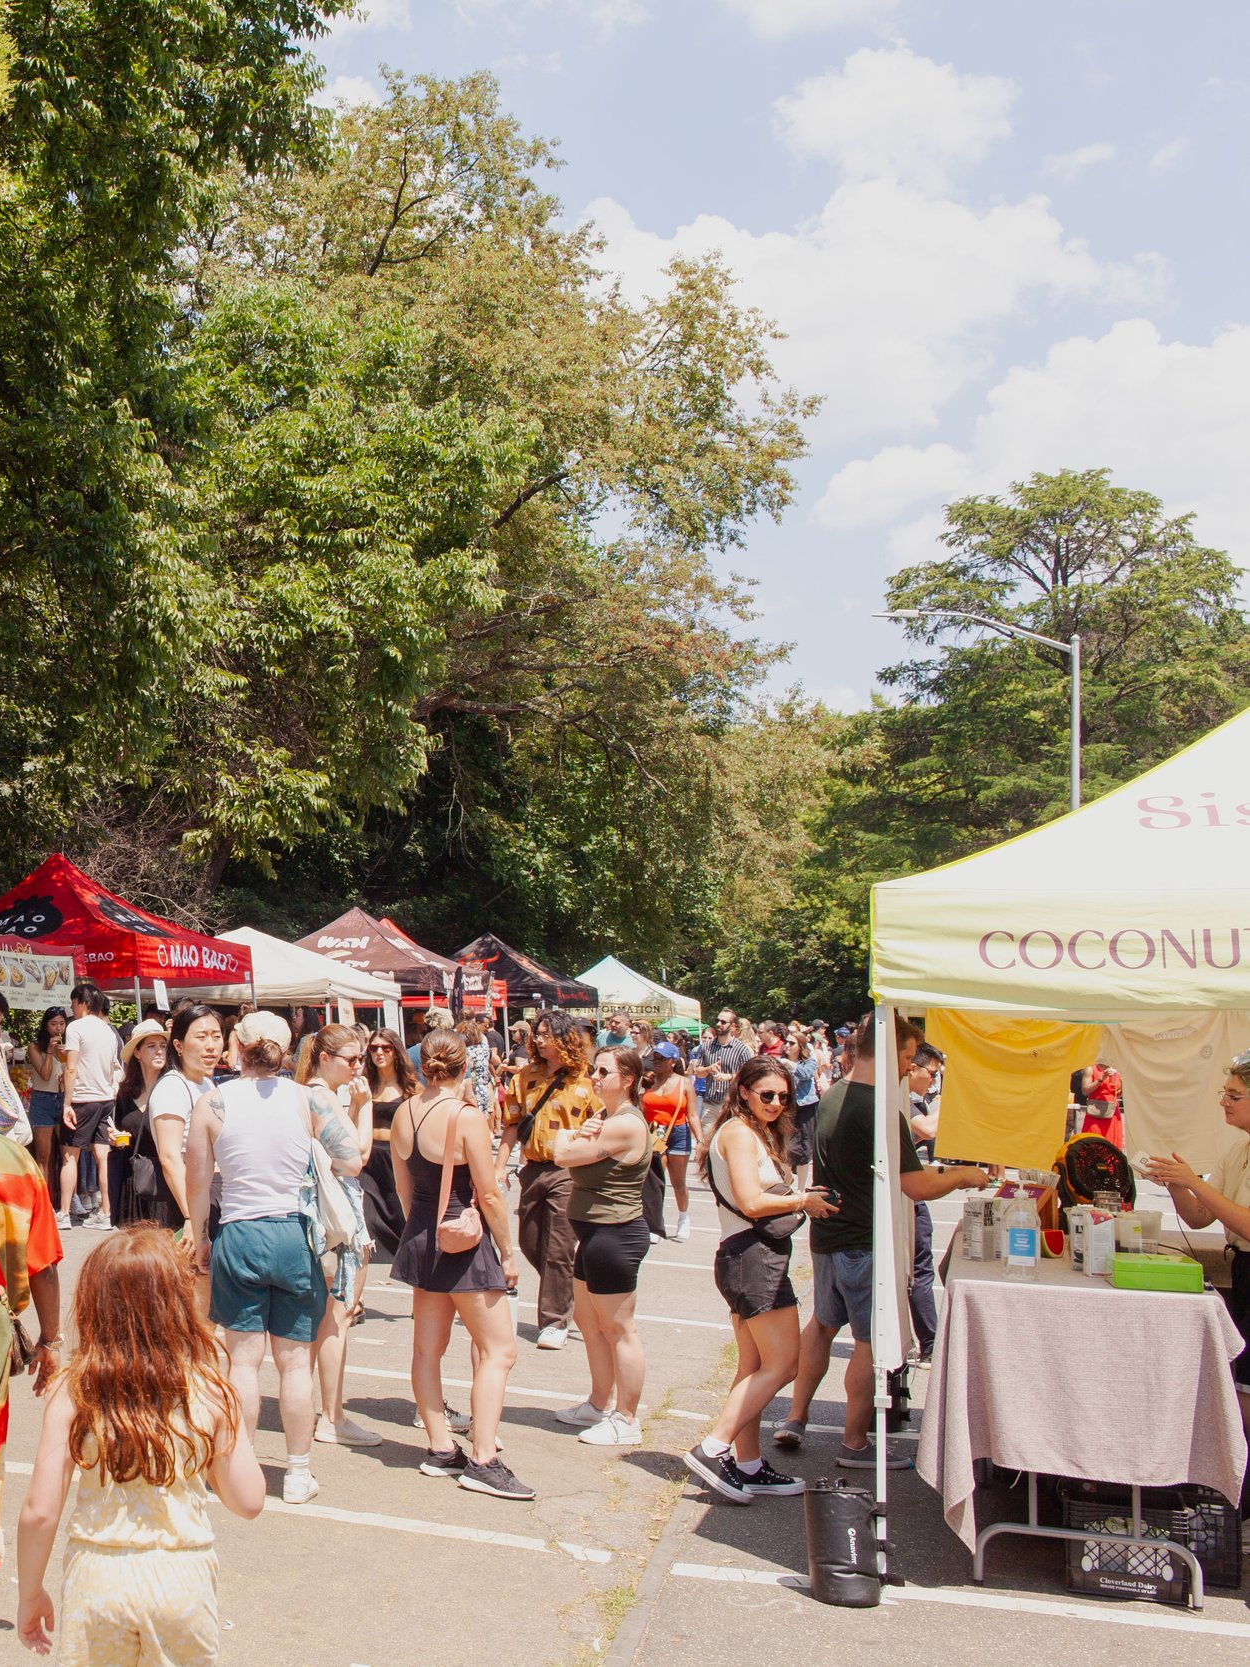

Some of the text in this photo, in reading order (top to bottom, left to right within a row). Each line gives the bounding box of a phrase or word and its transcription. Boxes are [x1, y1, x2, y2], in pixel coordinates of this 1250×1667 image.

[170, 944, 227, 971] MAO BAO
[979, 929, 1250, 970] COCONU
[1099, 1576, 1158, 1592] Cloverland Dairy
